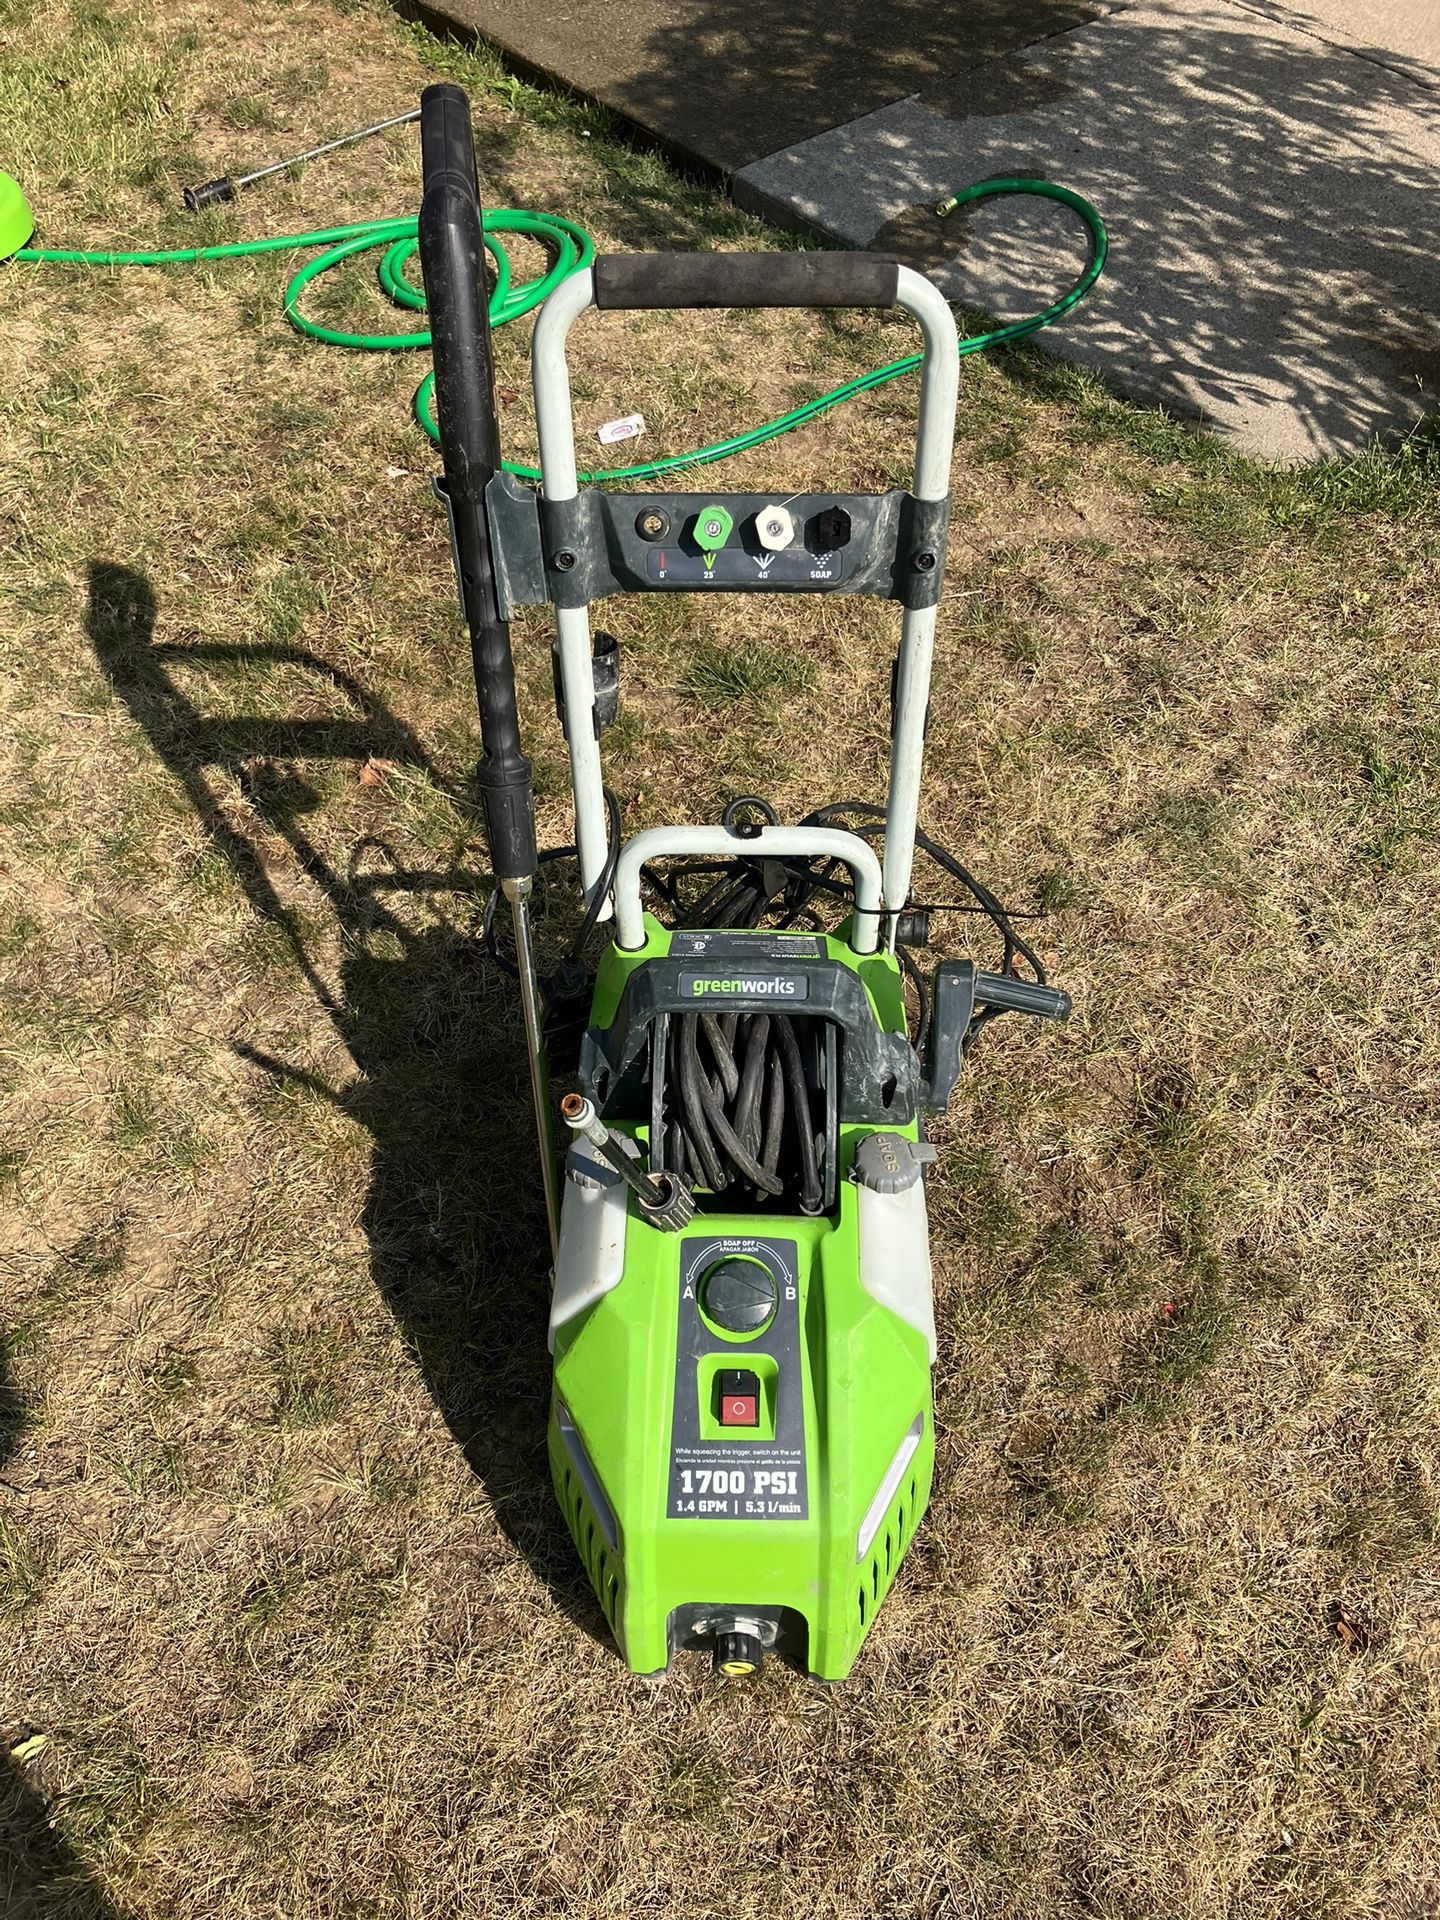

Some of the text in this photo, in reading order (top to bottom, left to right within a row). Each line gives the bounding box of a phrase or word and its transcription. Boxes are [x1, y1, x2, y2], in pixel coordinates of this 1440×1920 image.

[810, 570, 833, 579] SOAP
[692, 977, 795, 998] greenworks
[877, 1135, 901, 1173] SOAP
[683, 1286, 694, 1299] A
[785, 1287, 797, 1301] B
[675, 1447, 692, 1455] While
[680, 1470, 798, 1495] 1700 PSI
[676, 1500, 696, 1512] 1.4
[698, 1500, 728, 1513] GPM
[745, 1501, 765, 1513] 5.3
[768, 1501, 802, 1514] l/min
